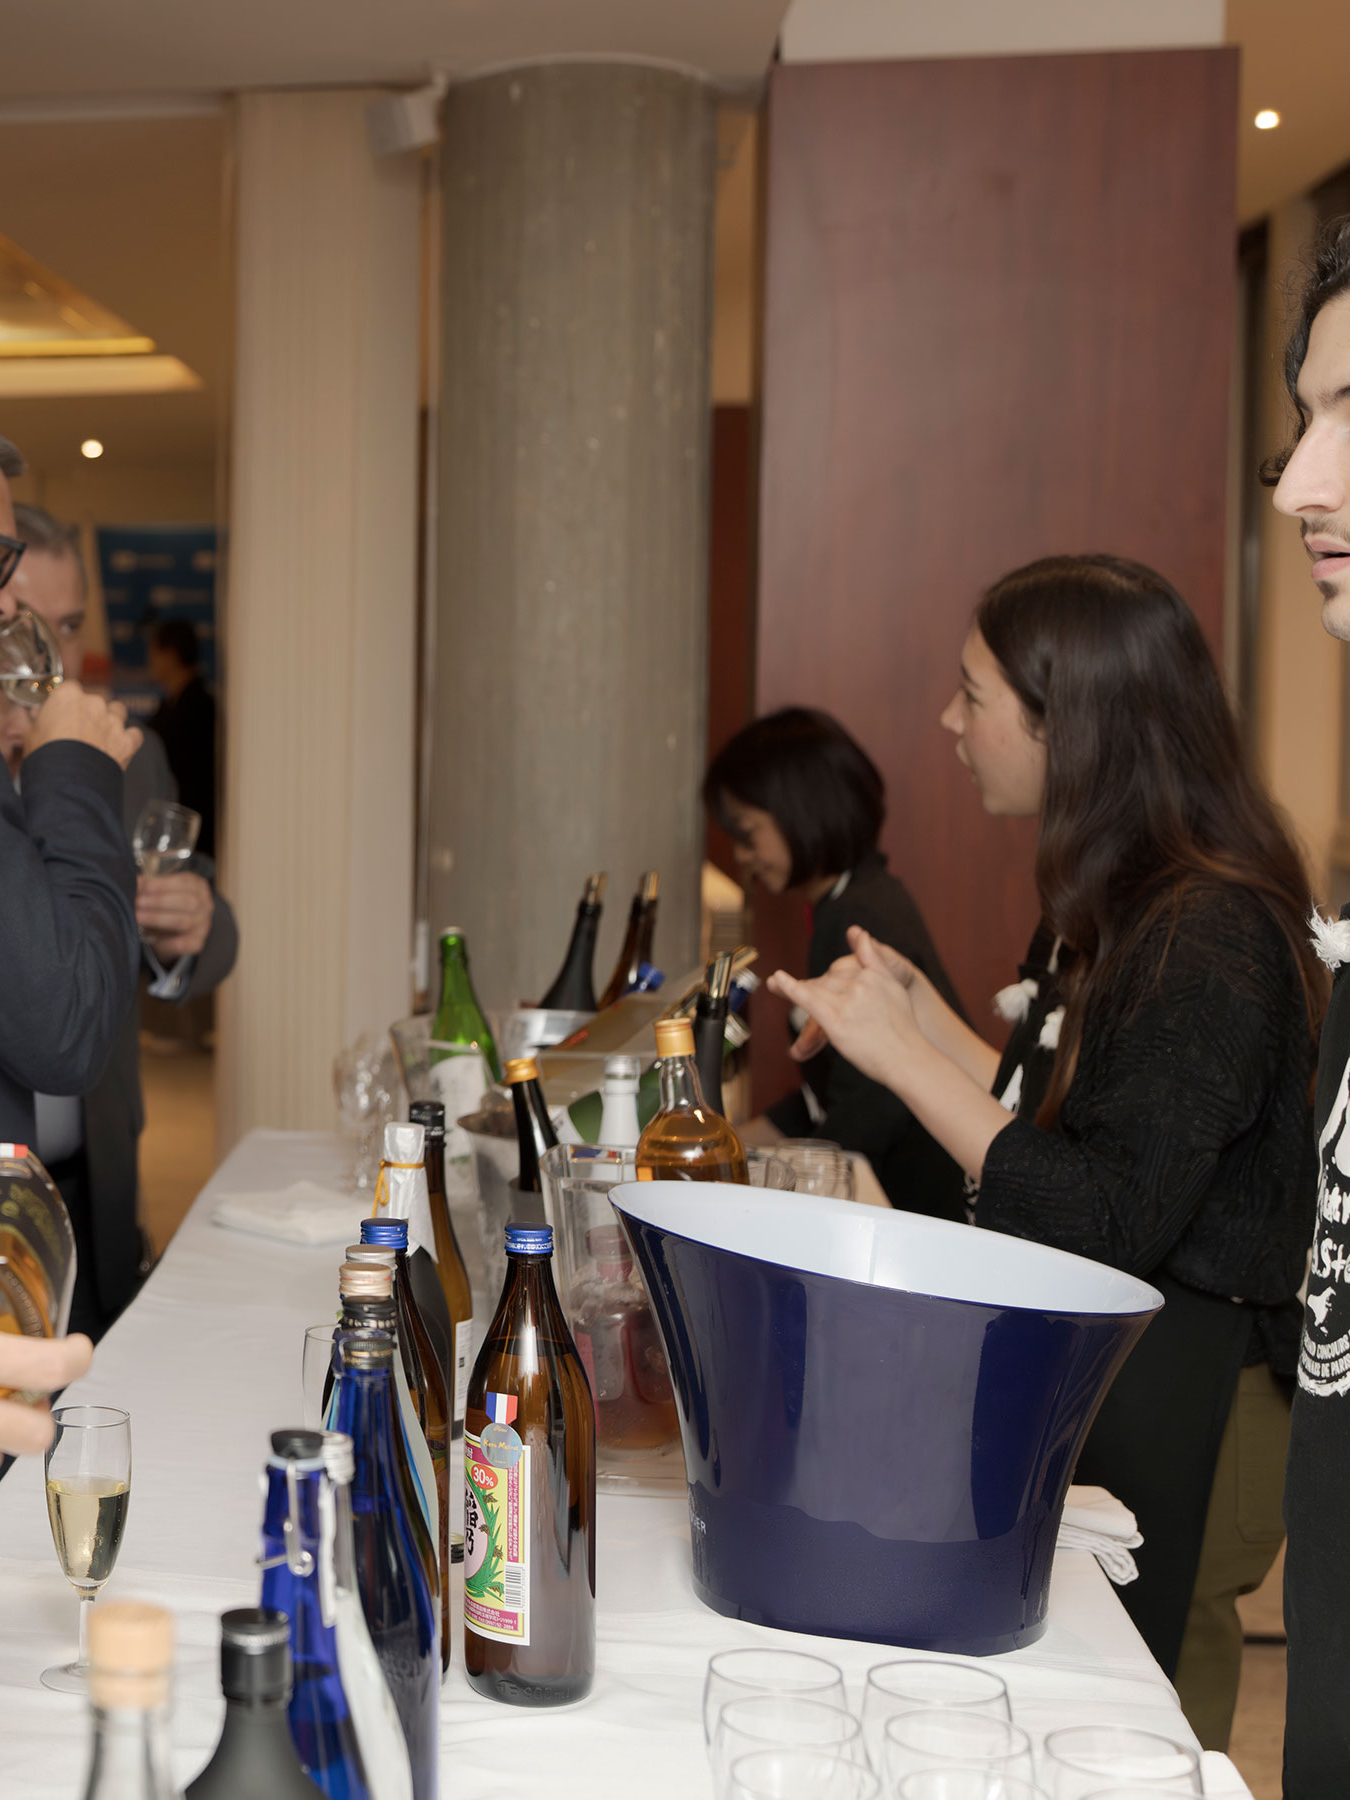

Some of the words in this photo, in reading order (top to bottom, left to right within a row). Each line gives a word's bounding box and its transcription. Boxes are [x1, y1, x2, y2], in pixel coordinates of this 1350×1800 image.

[1316, 1334, 1350, 1360] CONCOURS
[1320, 1362, 1330, 1378] DE
[473, 1466, 495, 1487] 30%
